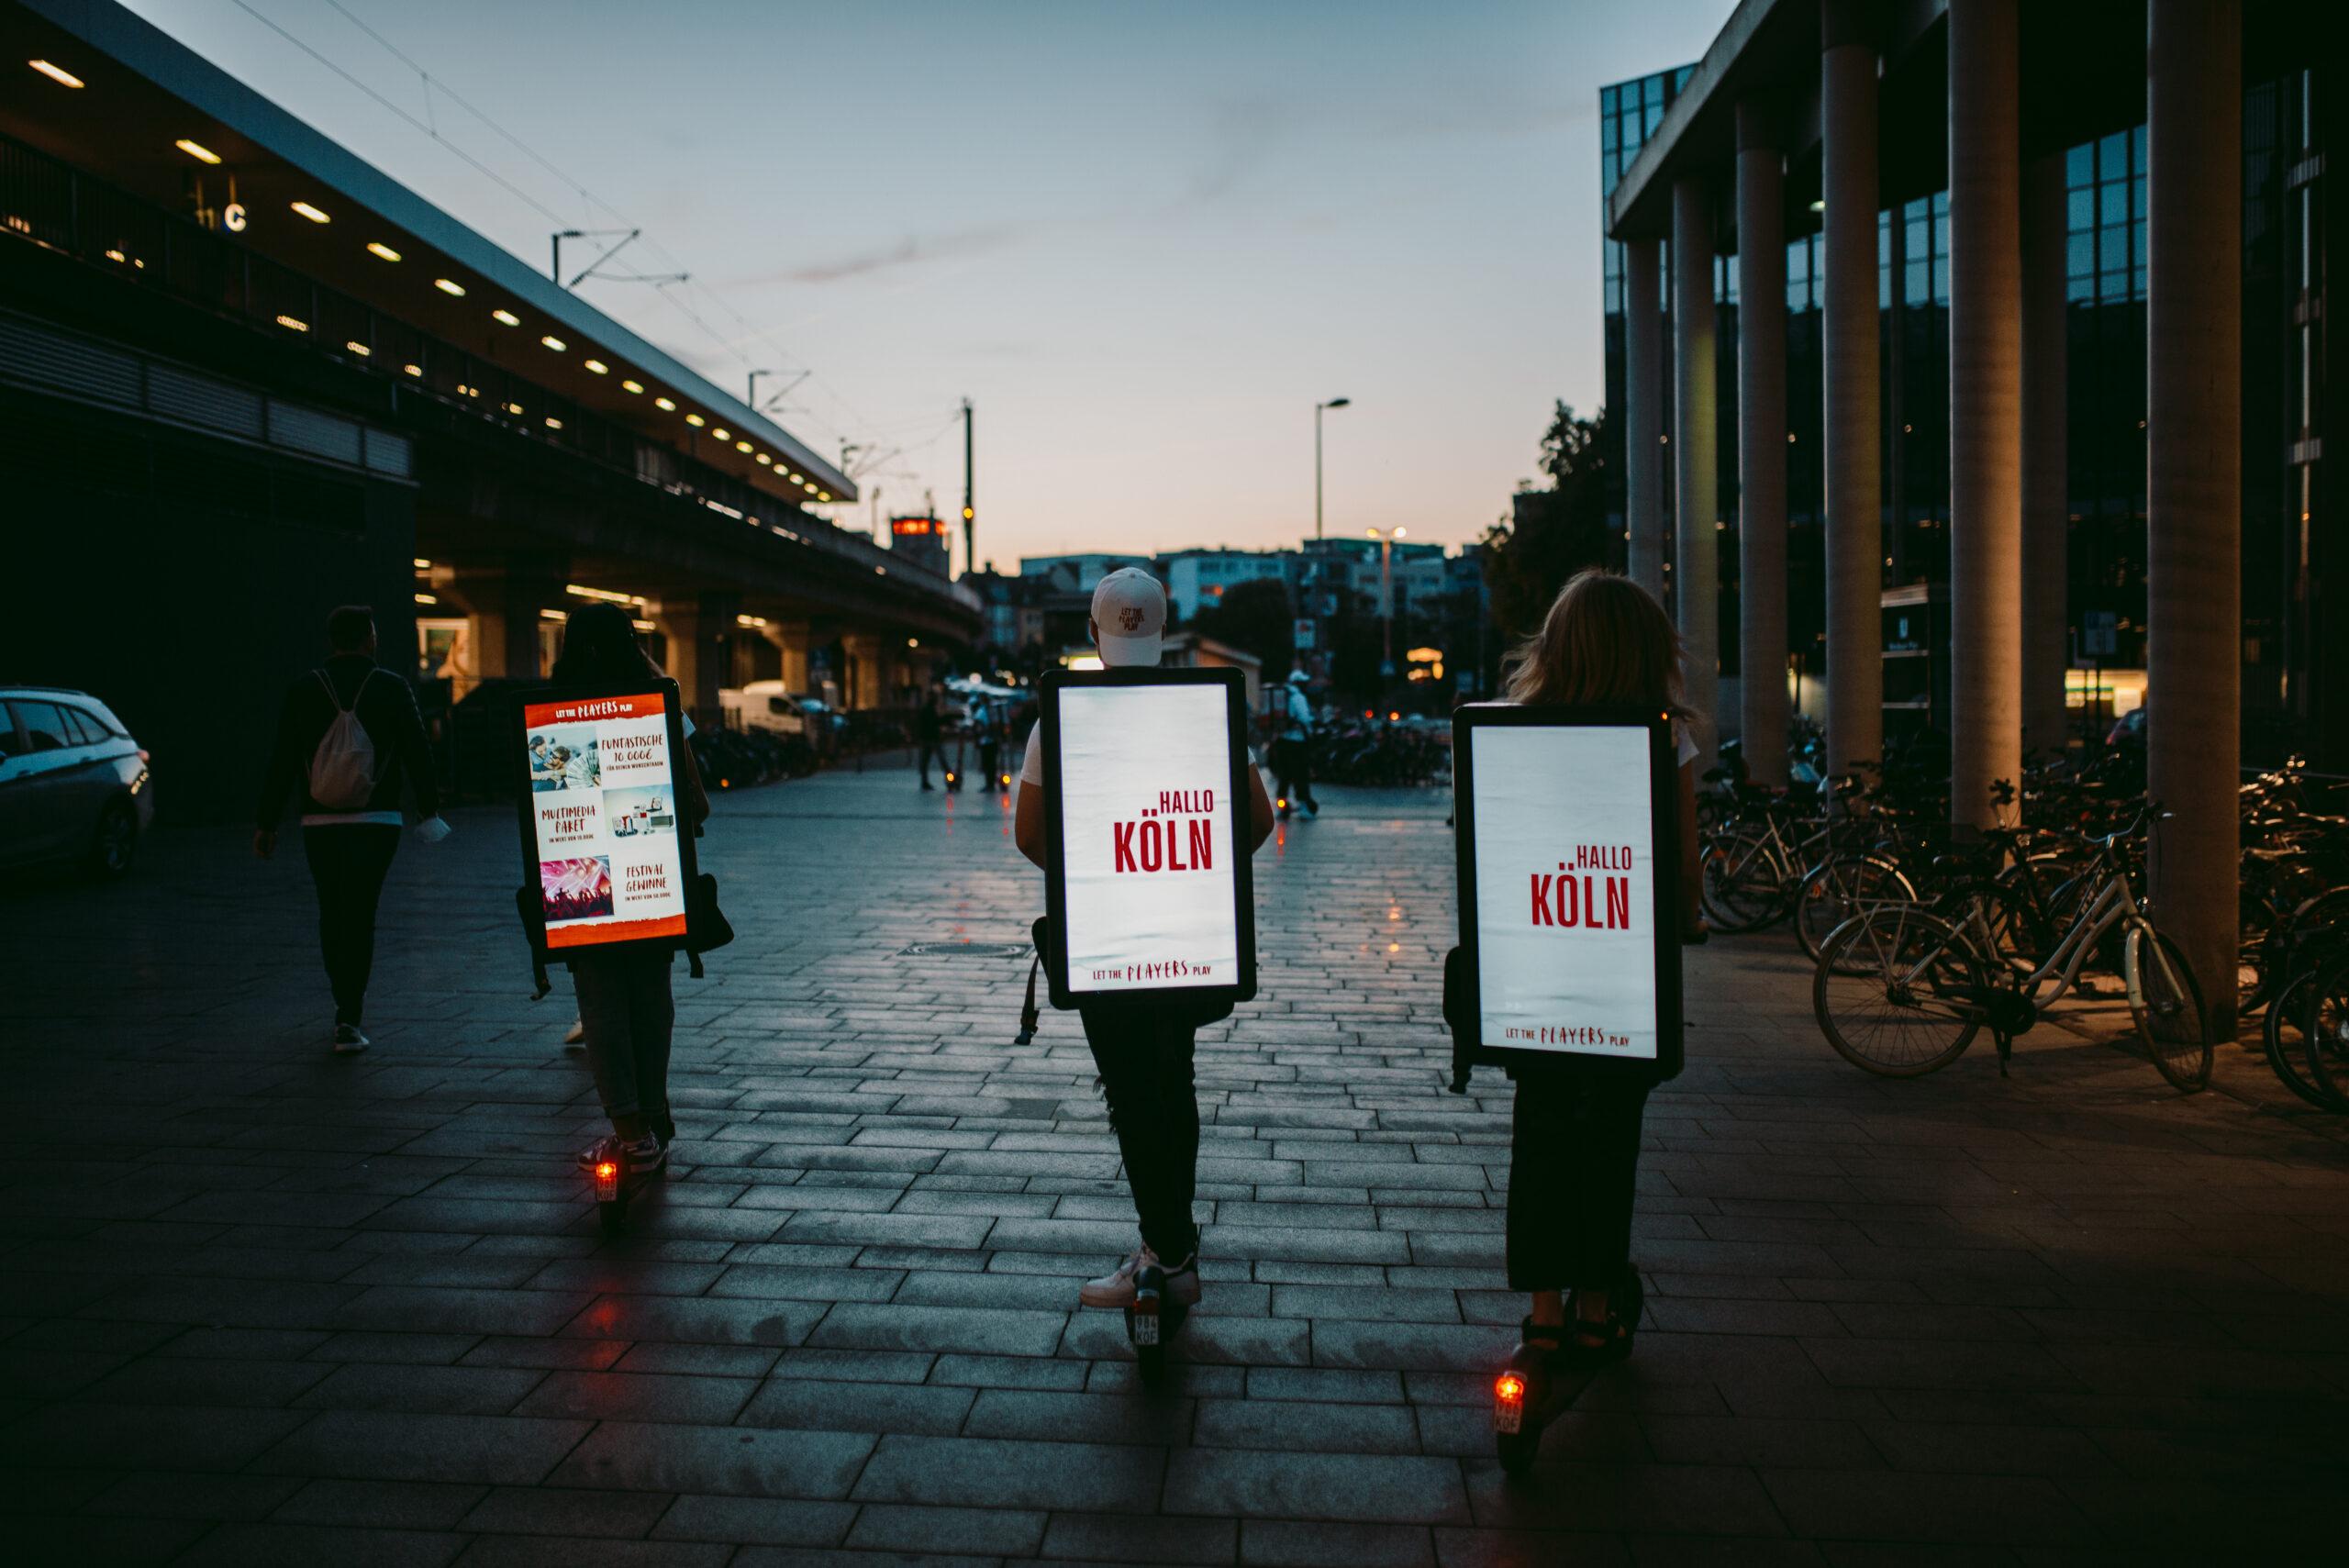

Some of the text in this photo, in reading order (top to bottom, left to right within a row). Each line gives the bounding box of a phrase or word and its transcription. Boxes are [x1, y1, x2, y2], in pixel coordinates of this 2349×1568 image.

[556, 709, 565, 718] LET
[578, 701, 618, 718] PLAYERS
[602, 734, 663, 751] FUNTASTISCHE
[1160, 790, 1214, 814] HALLO
[542, 806, 596, 820] MULTIMEDIA
[555, 818, 586, 833] PAKET
[1114, 808, 1212, 873] KÖLN
[1577, 844, 1632, 870] HALLO
[627, 863, 663, 878] FESTIVAL
[626, 877, 666, 892] GEWINNE
[1531, 862, 1630, 929] KÖLN
[1093, 960, 1211, 982] LET THE PLAYERS PLAY
[1506, 1027, 1630, 1046] LET THE PLAYERS PLAY
